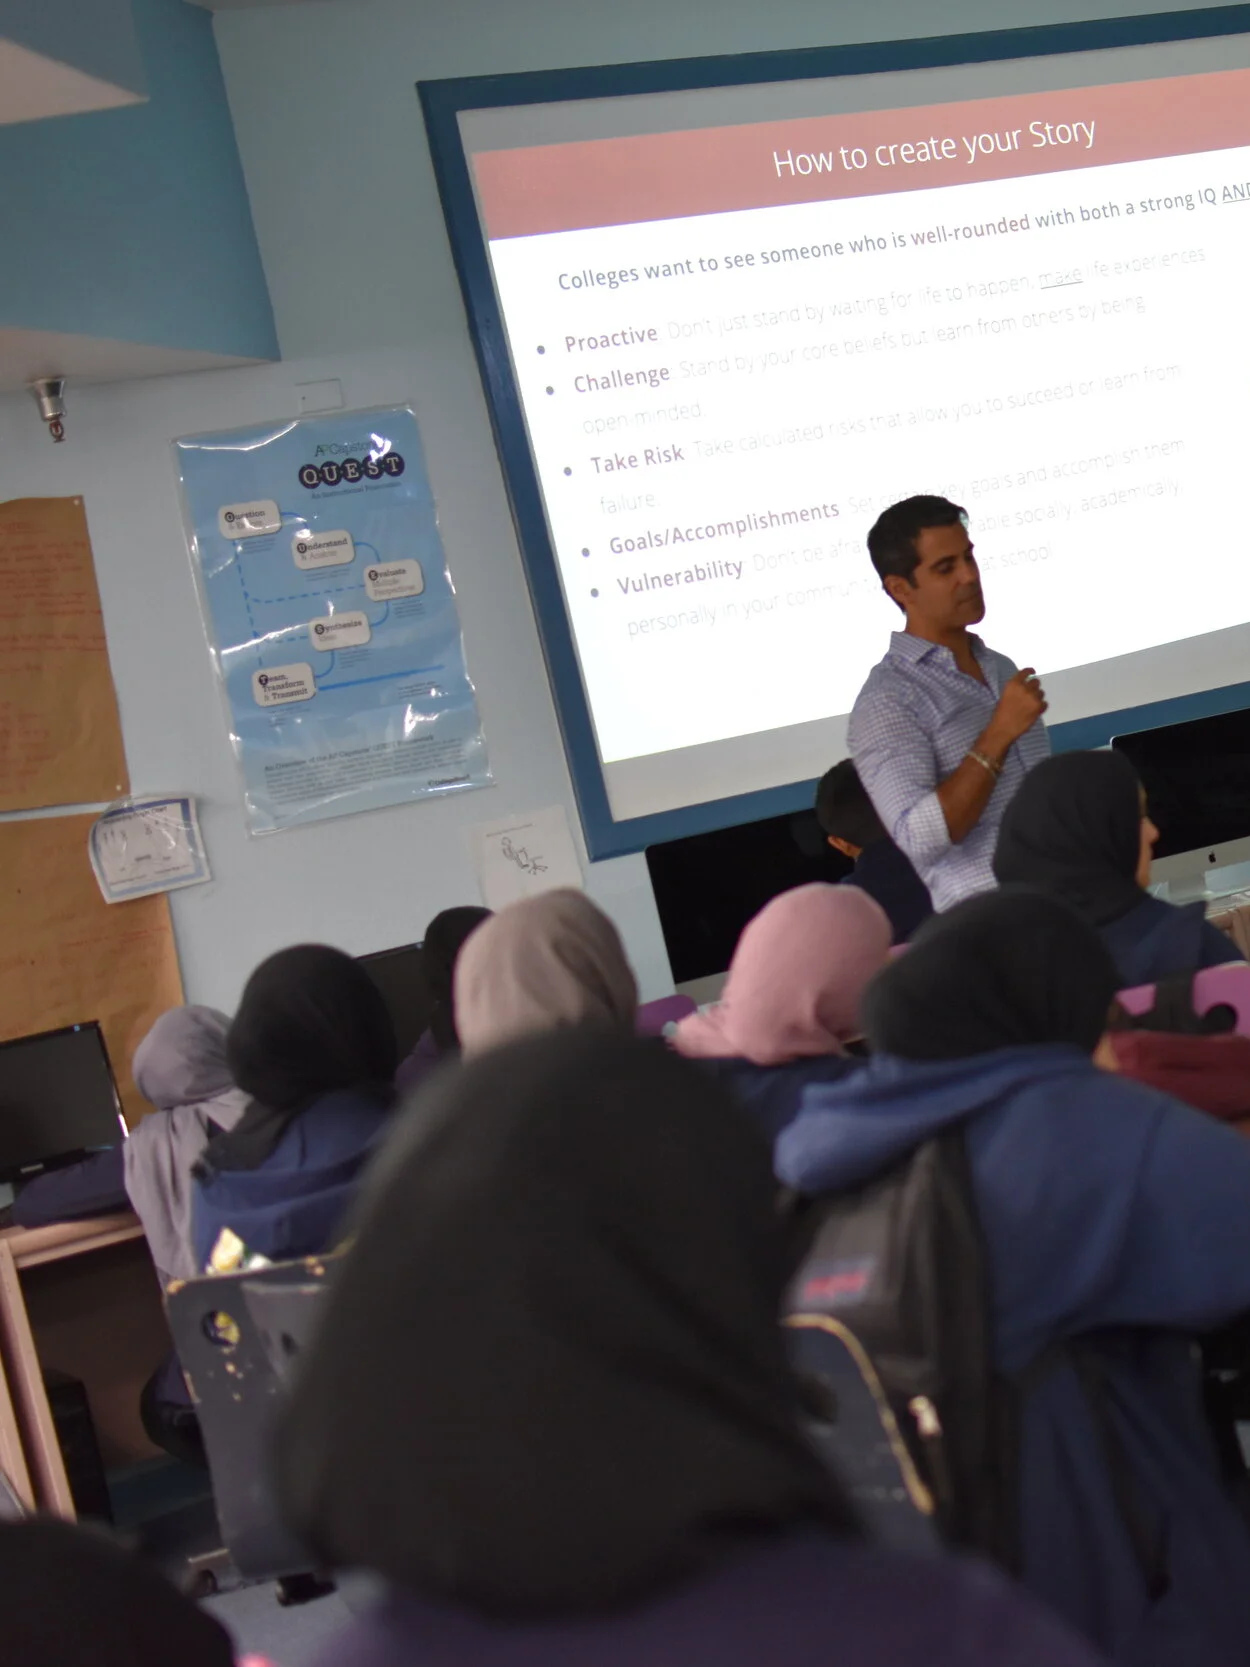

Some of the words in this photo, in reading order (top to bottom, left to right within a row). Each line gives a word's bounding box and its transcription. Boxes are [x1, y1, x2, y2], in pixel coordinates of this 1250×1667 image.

[772, 149, 833, 178] How
[839, 145, 868, 171] to
[874, 136, 958, 167] create
[963, 127, 1022, 164] your
[1029, 118, 1097, 149] Story
[558, 265, 640, 291] Colleges
[644, 259, 694, 279] want
[698, 257, 719, 272] to
[724, 254, 755, 269] see
[760, 241, 844, 265] someone
[848, 234, 887, 254] who
[892, 231, 907, 248] is
[910, 213, 1031, 246] well-rounded
[1035, 207, 1075, 229] with
[1080, 200, 1121, 222] both
[1126, 200, 1135, 215] a
[1140, 190, 1196, 214] strong
[1198, 187, 1218, 209] IQ
[717, 314, 749, 337] just
[753, 307, 801, 328] stand
[804, 302, 825, 325] by
[829, 294, 887, 317] waiting
[890, 290, 913, 309] for
[918, 287, 942, 305] life
[946, 286, 963, 302] to
[1038, 266, 1084, 290] make
[1113, 247, 1206, 276] experiences
[679, 354, 730, 379] Stand
[734, 352, 755, 374] by
[757, 347, 795, 369] your
[802, 343, 839, 361] core
[901, 329, 929, 348] but
[978, 314, 1018, 334] from
[1021, 304, 1075, 328] others
[1078, 301, 1098, 322] by
[1101, 294, 1147, 316] being
[590, 452, 639, 475] Take
[692, 438, 734, 459] Take
[738, 422, 825, 451] calculated
[870, 410, 903, 431] that
[907, 405, 948, 424] allow
[952, 401, 982, 424] you
[986, 396, 1003, 413] to
[1007, 382, 1075, 408] succeed
[1078, 380, 1095, 396] or
[1143, 363, 1181, 384] from
[848, 496, 876, 515] Set
[1017, 466, 1047, 486] and
[1144, 438, 1186, 460] them
[296, 537, 348, 554] Understand
[803, 545, 824, 563] be
[626, 603, 718, 640] personally
[722, 600, 738, 618] in
[742, 596, 779, 620] your
